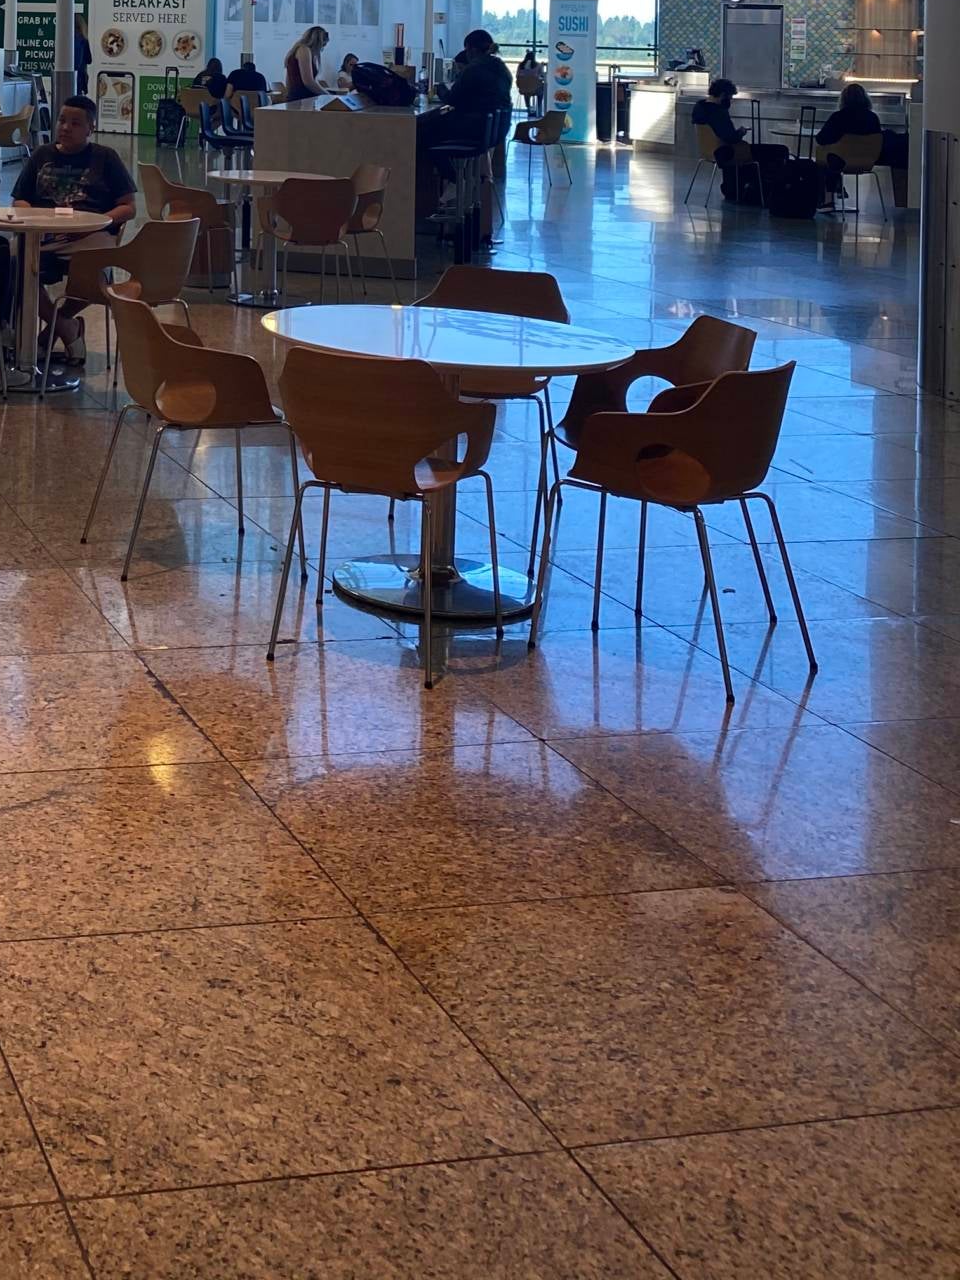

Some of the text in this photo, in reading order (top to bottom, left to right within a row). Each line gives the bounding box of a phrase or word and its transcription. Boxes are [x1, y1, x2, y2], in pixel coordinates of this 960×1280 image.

[18, 16, 40, 24] GRAB
[113, 12, 187, 24] SERVED HERE
[559, 16, 588, 32] SUSHI
[16, 39, 40, 47] NLINE
[20, 61, 38, 70] THIS
